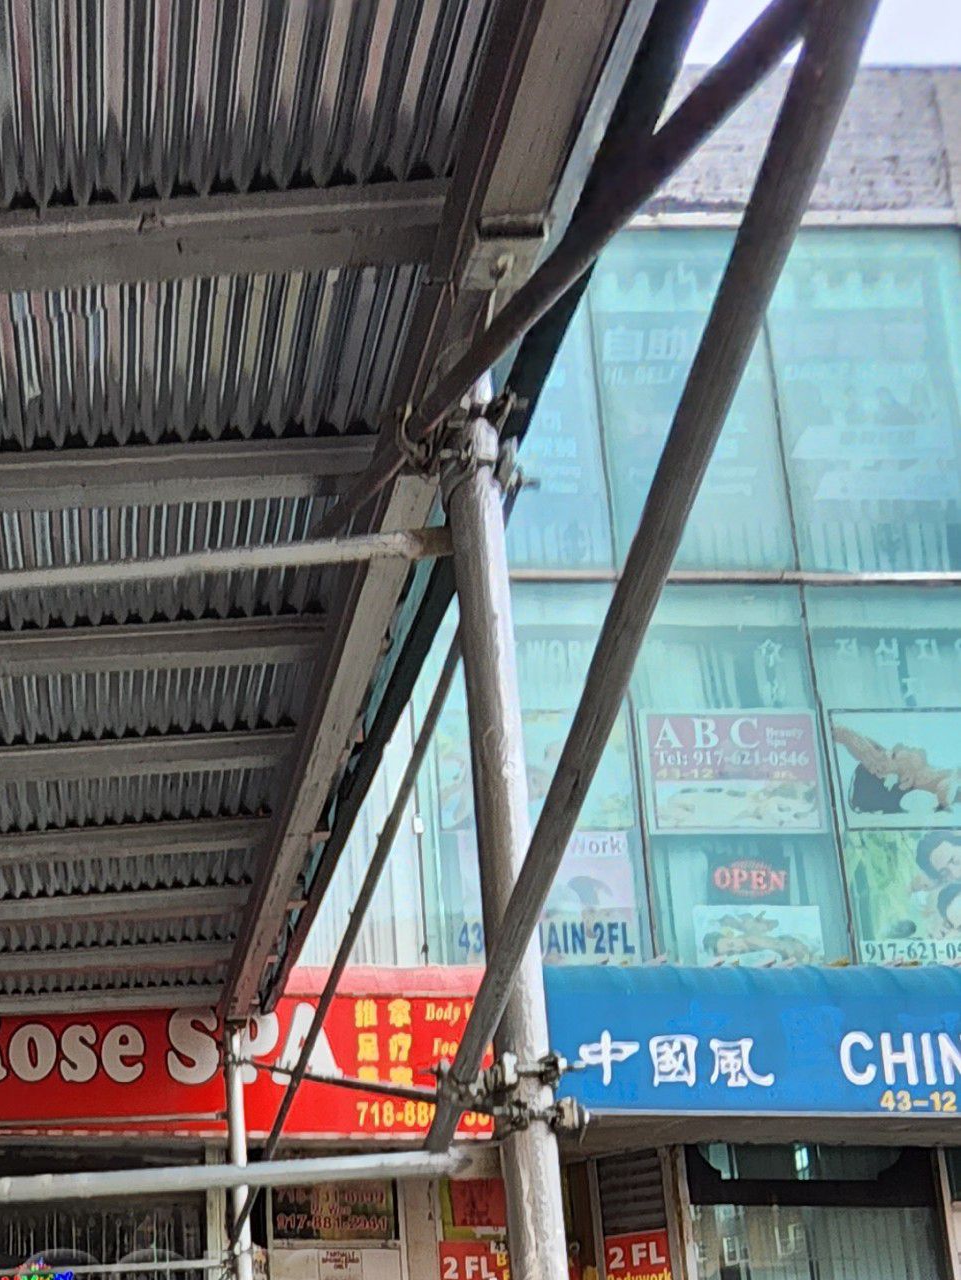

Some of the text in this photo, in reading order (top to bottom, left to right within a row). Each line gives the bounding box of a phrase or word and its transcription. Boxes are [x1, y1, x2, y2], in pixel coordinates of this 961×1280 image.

[714, 866, 786, 891] OPEN
[594, 921, 635, 954] 2FL
[425, 1002, 460, 1026] Body
[166, 1002, 342, 1086] SPA
[578, 1028, 775, 1089] 中國風
[880, 1090, 958, 1114] 43-12
[443, 1257, 459, 1280] 2
[465, 1256, 495, 1280] FL
[609, 1241, 666, 1270] 2 FL
